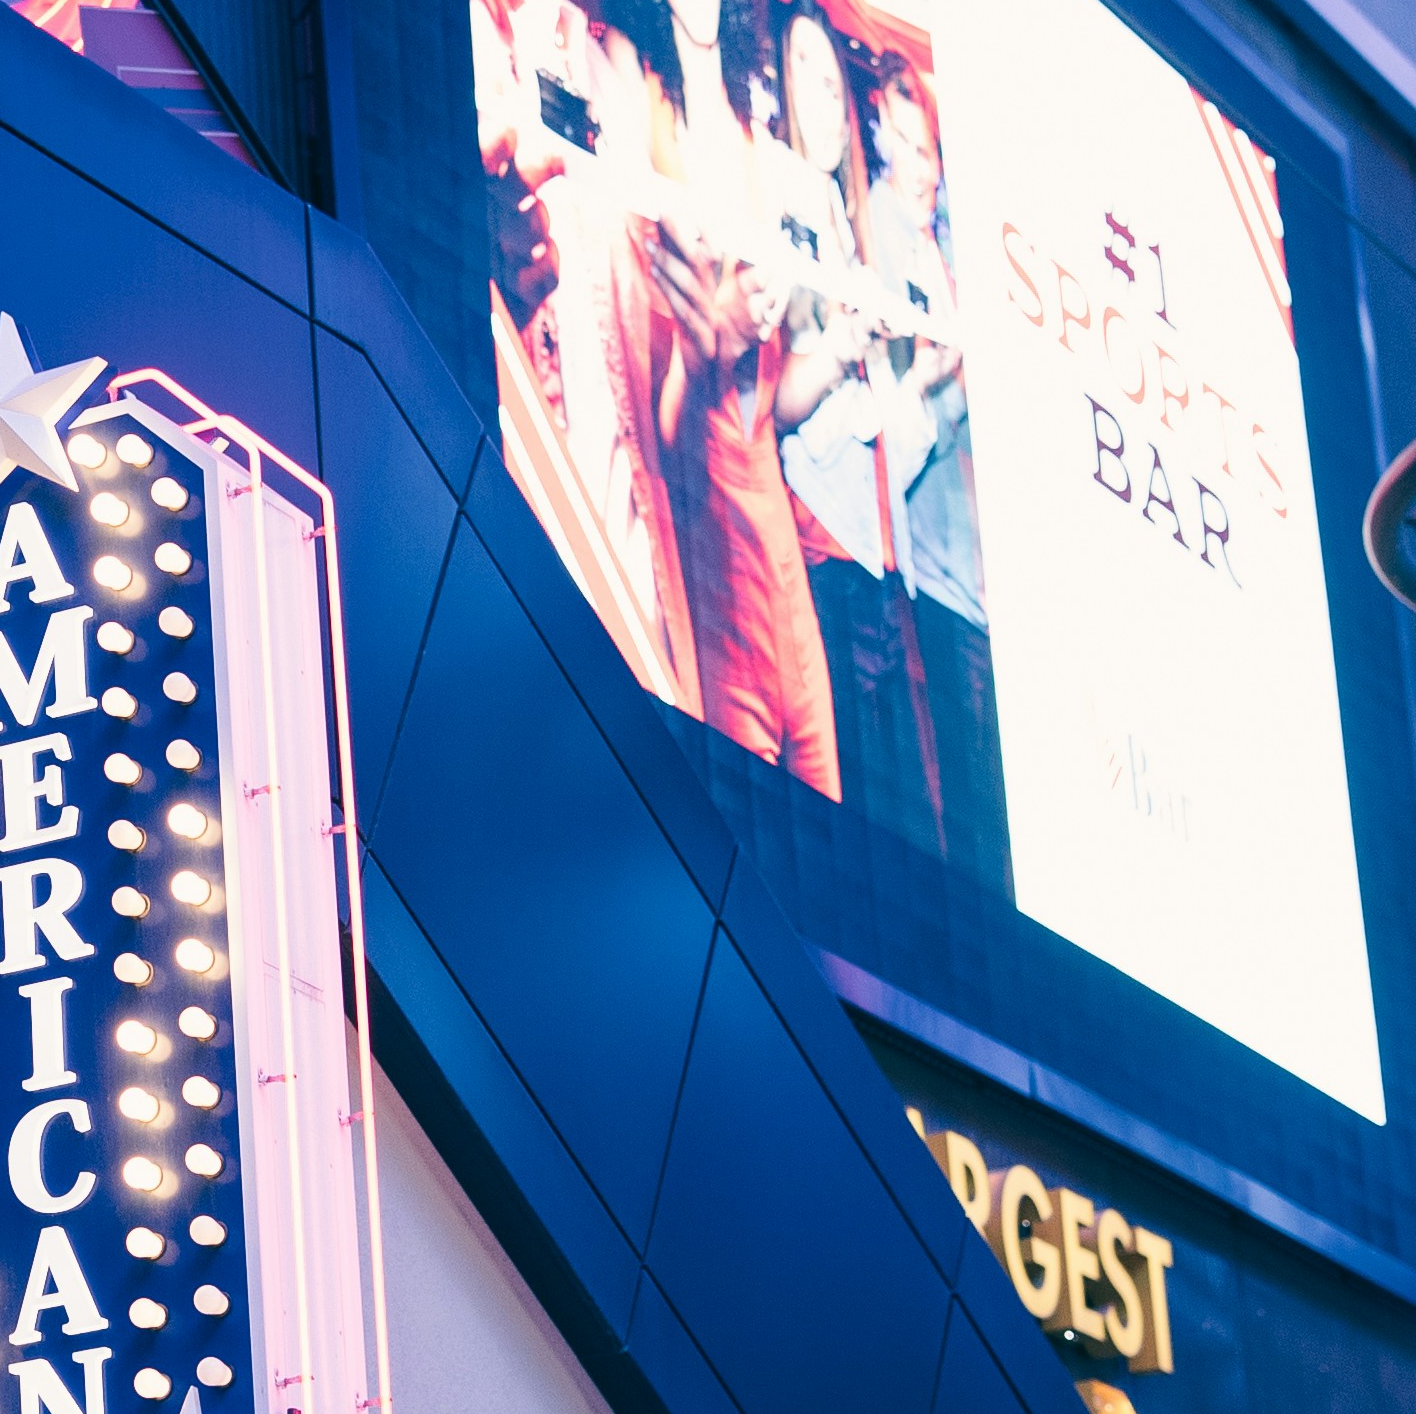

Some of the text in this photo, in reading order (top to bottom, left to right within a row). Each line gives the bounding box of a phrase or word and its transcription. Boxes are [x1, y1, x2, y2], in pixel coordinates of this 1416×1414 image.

[1103, 209, 1177, 331] #1
[1001, 221, 1287, 520] SPORTS
[1083, 391, 1243, 590] BAR
